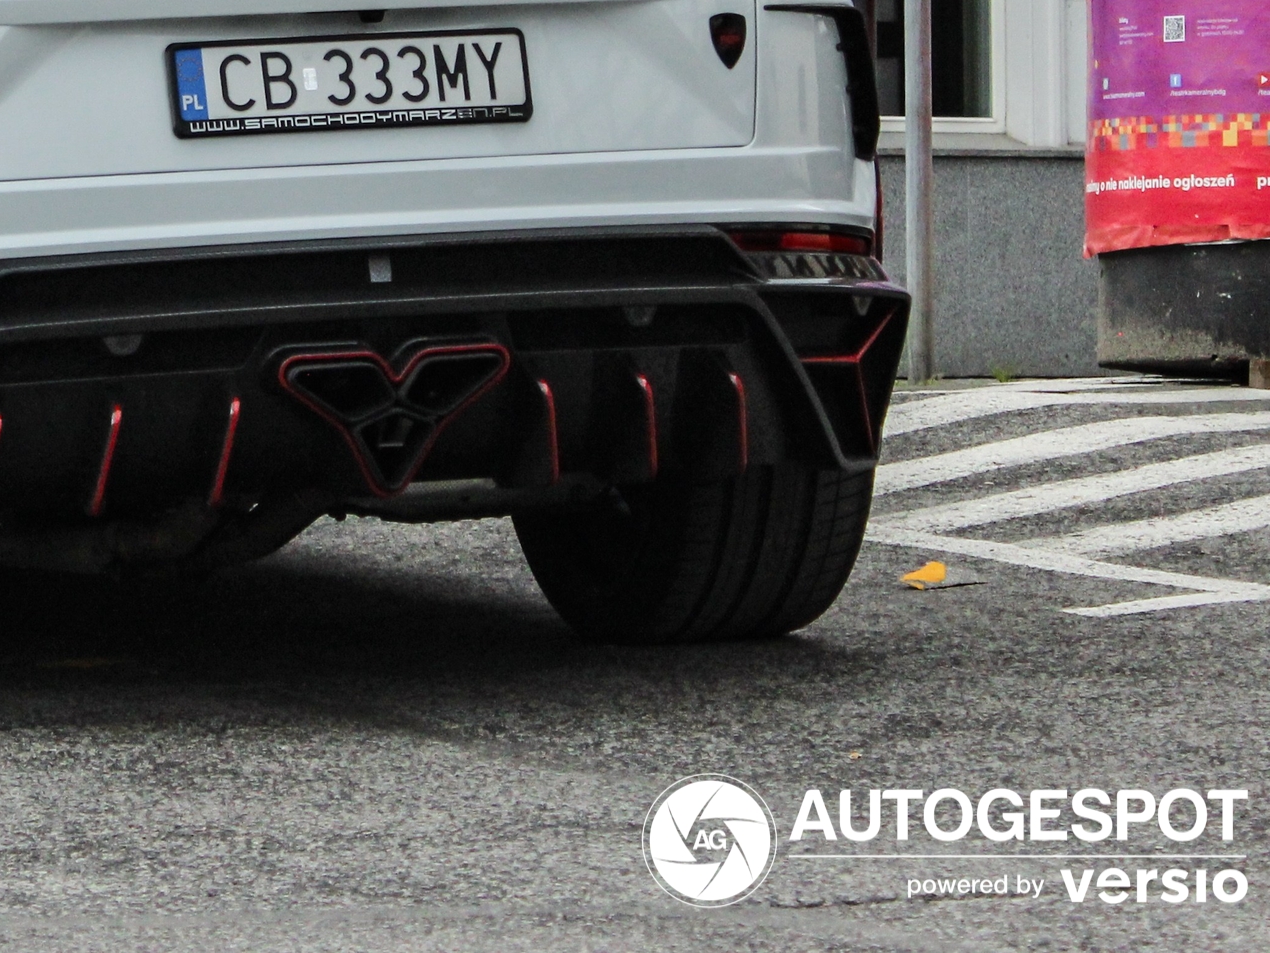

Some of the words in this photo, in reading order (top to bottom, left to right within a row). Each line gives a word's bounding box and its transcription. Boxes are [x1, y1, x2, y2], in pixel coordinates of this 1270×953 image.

[219, 51, 298, 111] CB
[323, 42, 503, 106] 333MY
[182, 95, 204, 111] PL
[1101, 181, 1105, 191] o
[1106, 178, 1117, 190] nie
[1119, 175, 1170, 192] naklejanie
[1174, 174, 1235, 191] ogłoszeń
